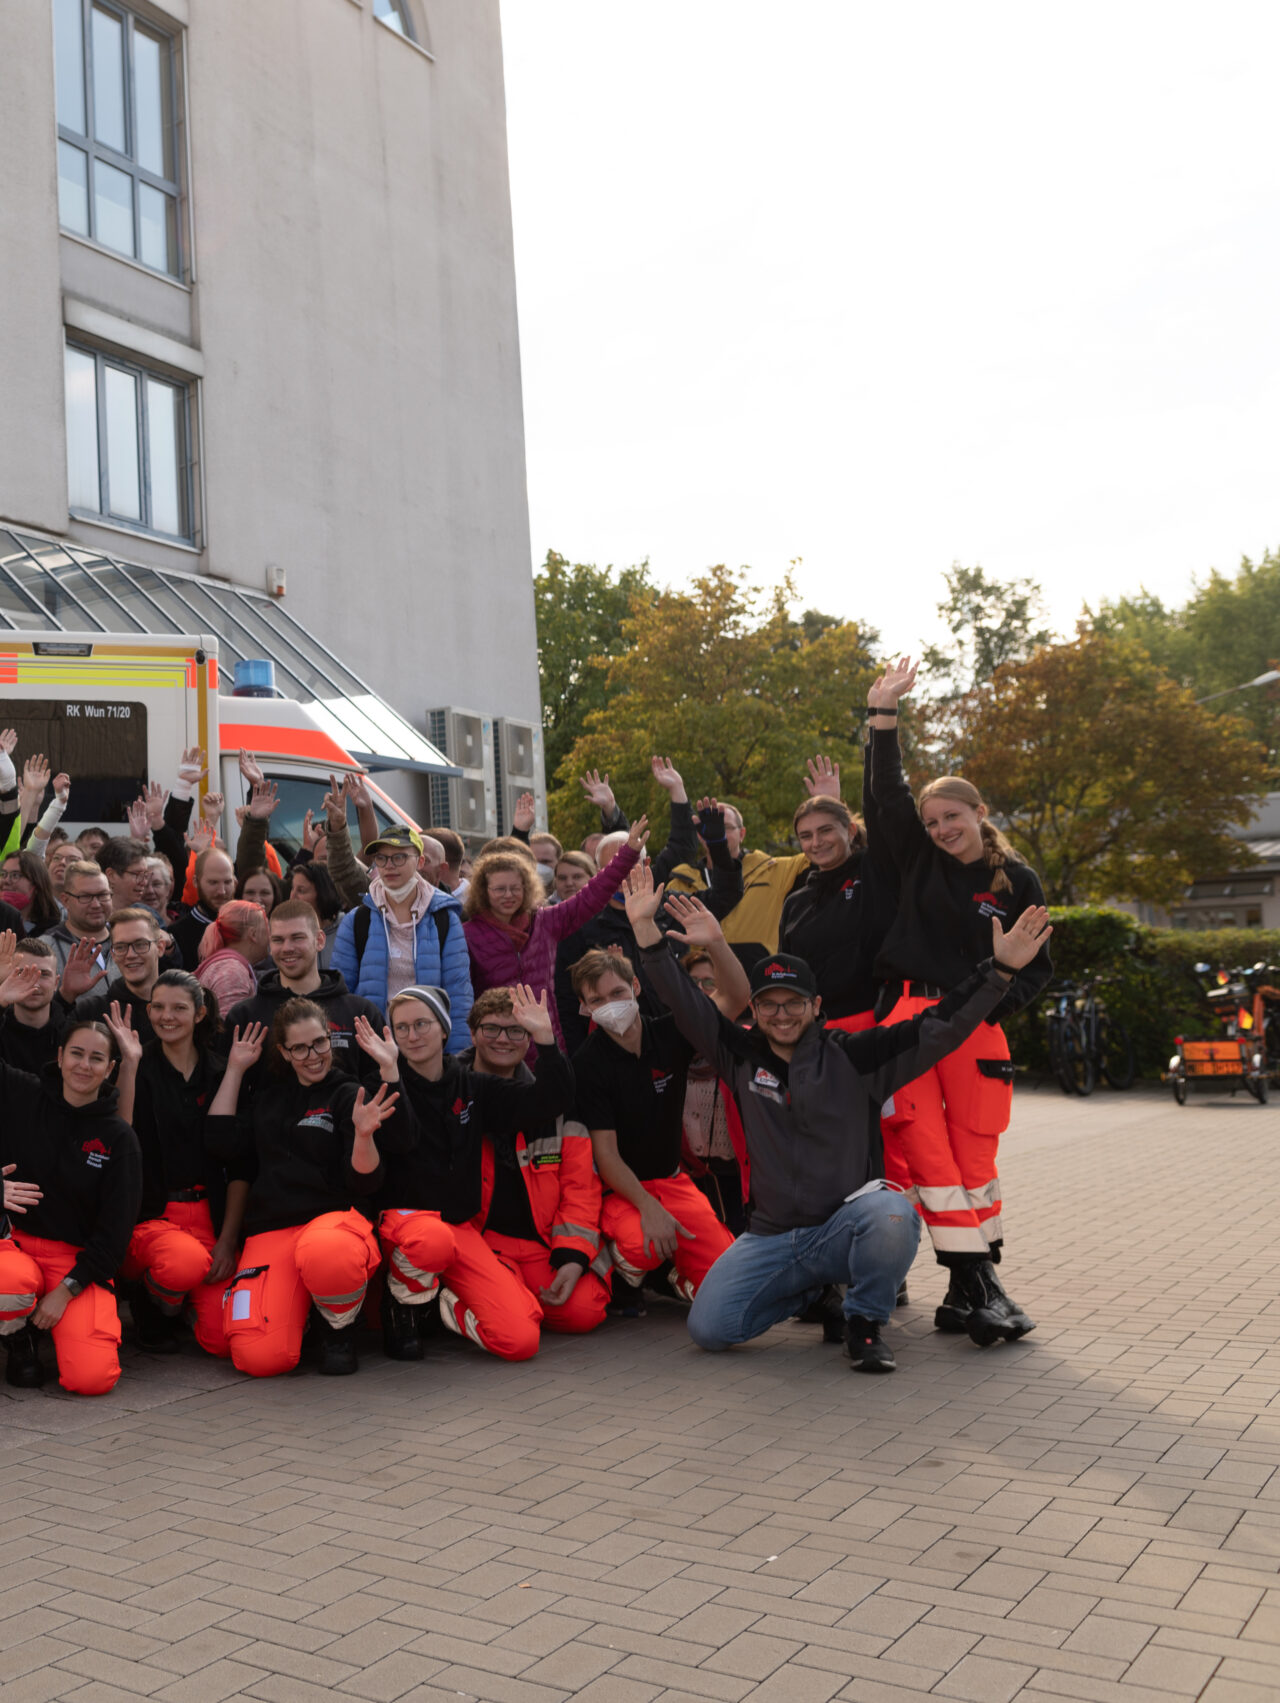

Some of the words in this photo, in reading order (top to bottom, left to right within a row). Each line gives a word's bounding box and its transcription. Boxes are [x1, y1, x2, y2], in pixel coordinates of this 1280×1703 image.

[66, 704, 80, 717] RK
[84, 704, 105, 717] Wun
[106, 705, 131, 718] 71/20
